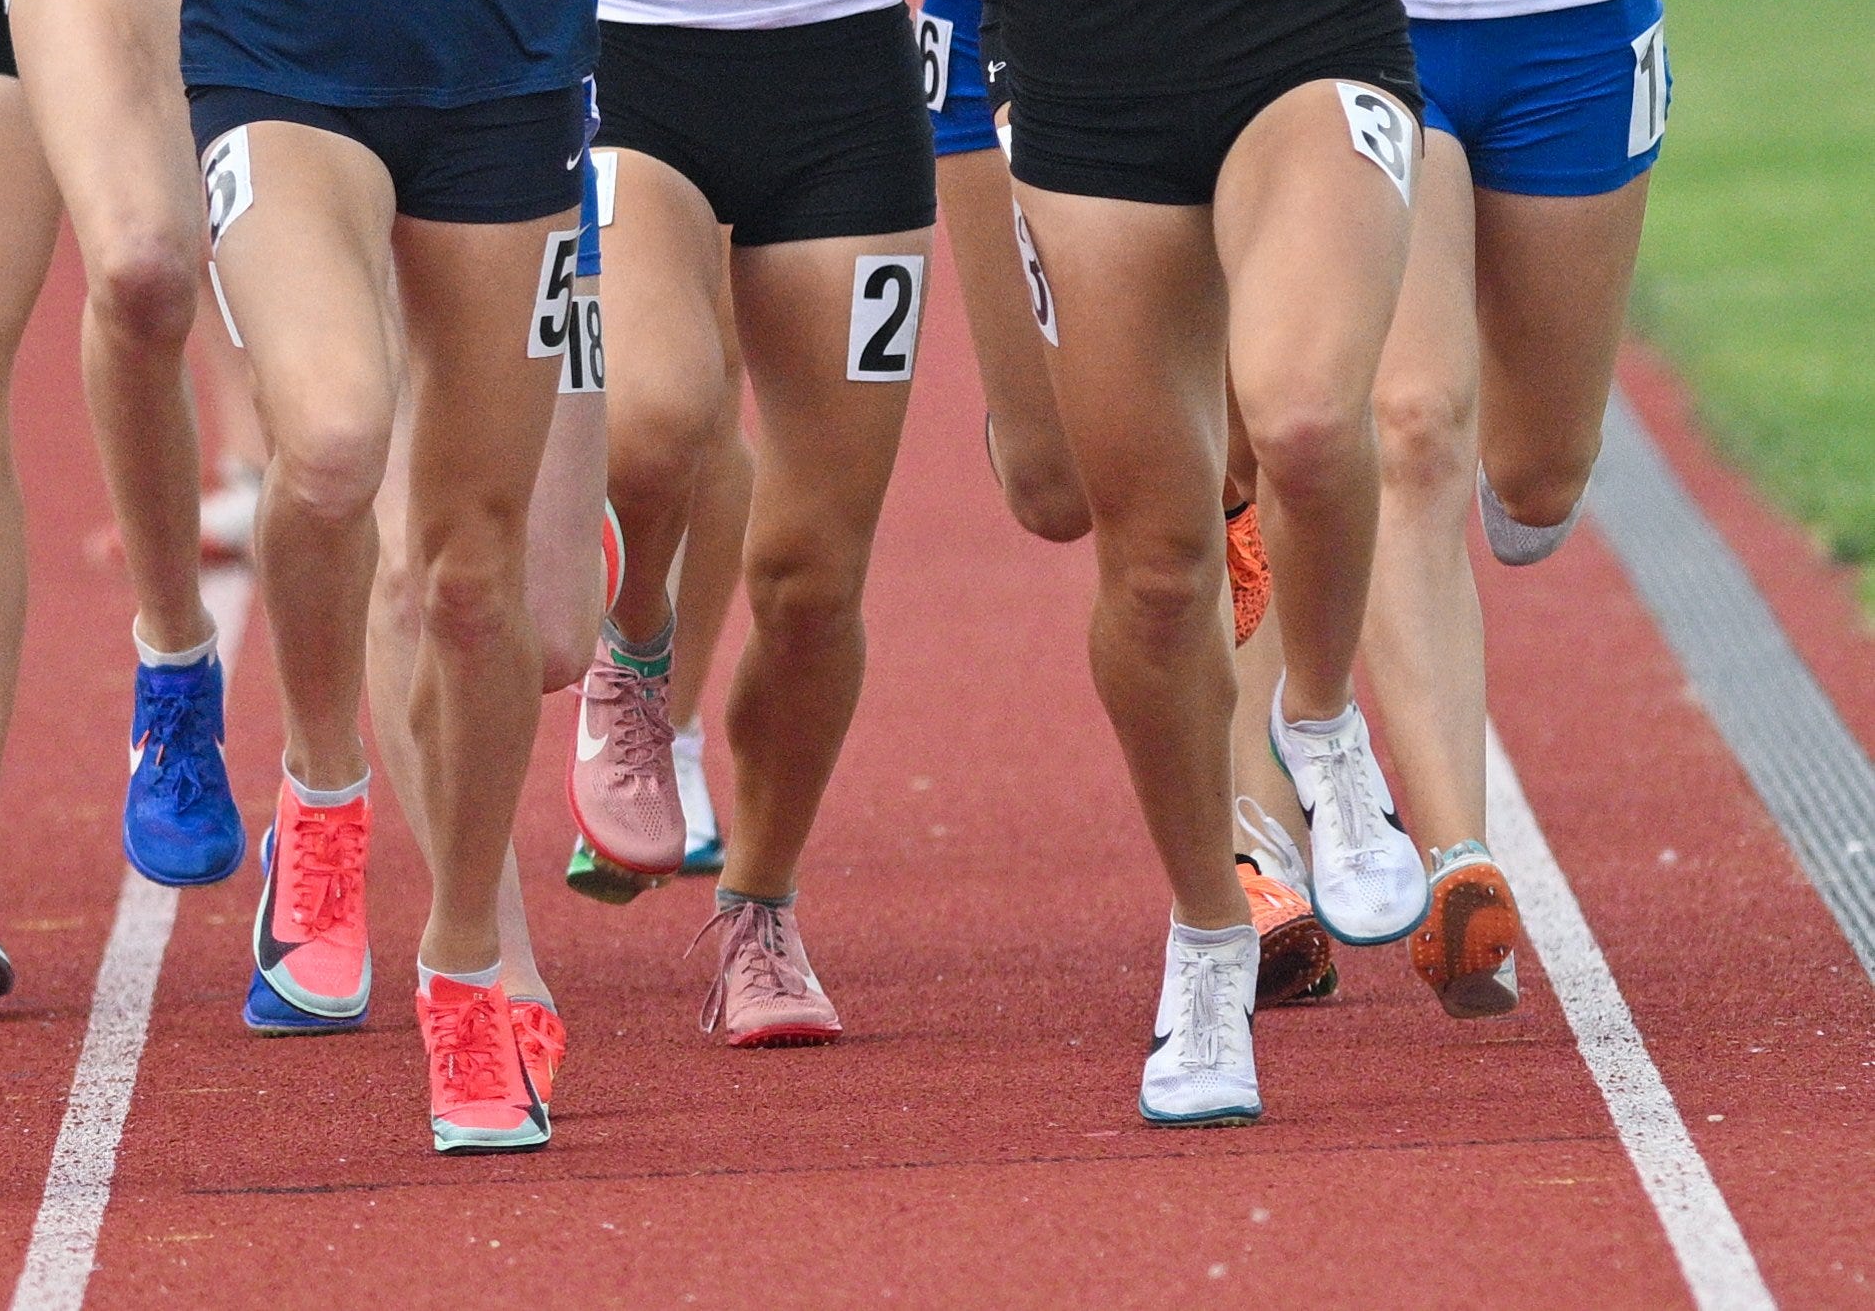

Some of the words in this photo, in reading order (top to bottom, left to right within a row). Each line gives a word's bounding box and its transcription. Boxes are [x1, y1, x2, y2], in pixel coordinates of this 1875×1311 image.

[1354, 94, 1406, 182] 3
[568, 300, 605, 390] 18
[858, 264, 913, 372] 2
